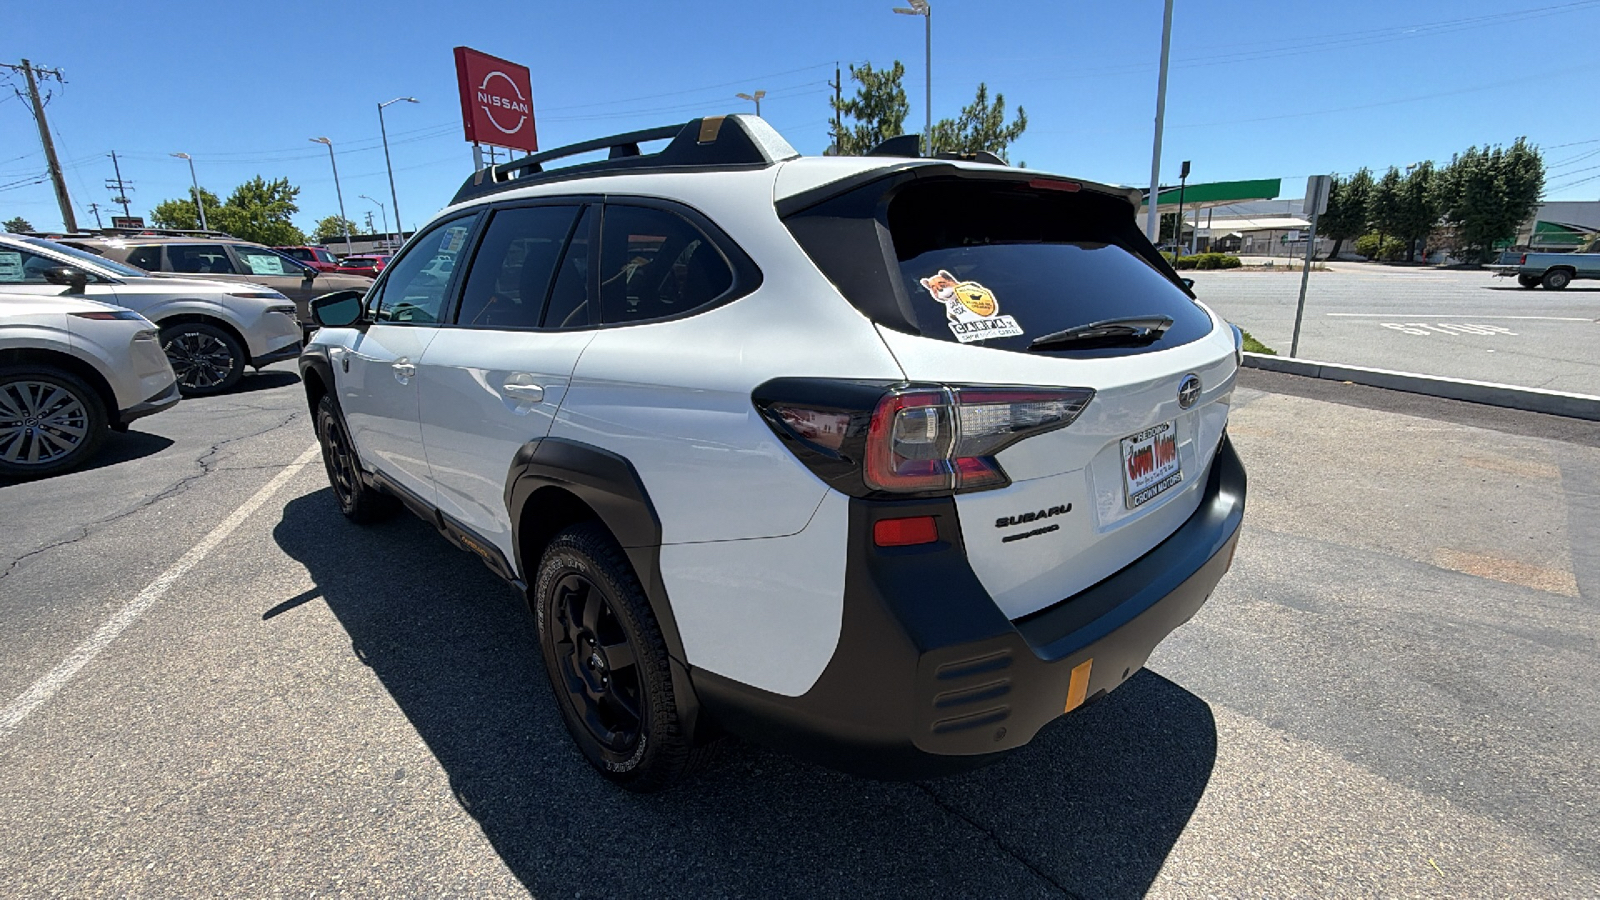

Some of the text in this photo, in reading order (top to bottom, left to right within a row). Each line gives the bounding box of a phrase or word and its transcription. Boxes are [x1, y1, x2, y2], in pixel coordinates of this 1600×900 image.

[478, 92, 528, 114] NISSAN
[954, 318, 1016, 334] CARFAX
[1380, 322, 1519, 335] STOP
[1137, 424, 1168, 442] REDDING
[1134, 484, 1158, 506] CROWN
[1158, 473, 1181, 493] MOTORS
[995, 503, 1072, 528] SUBARU
